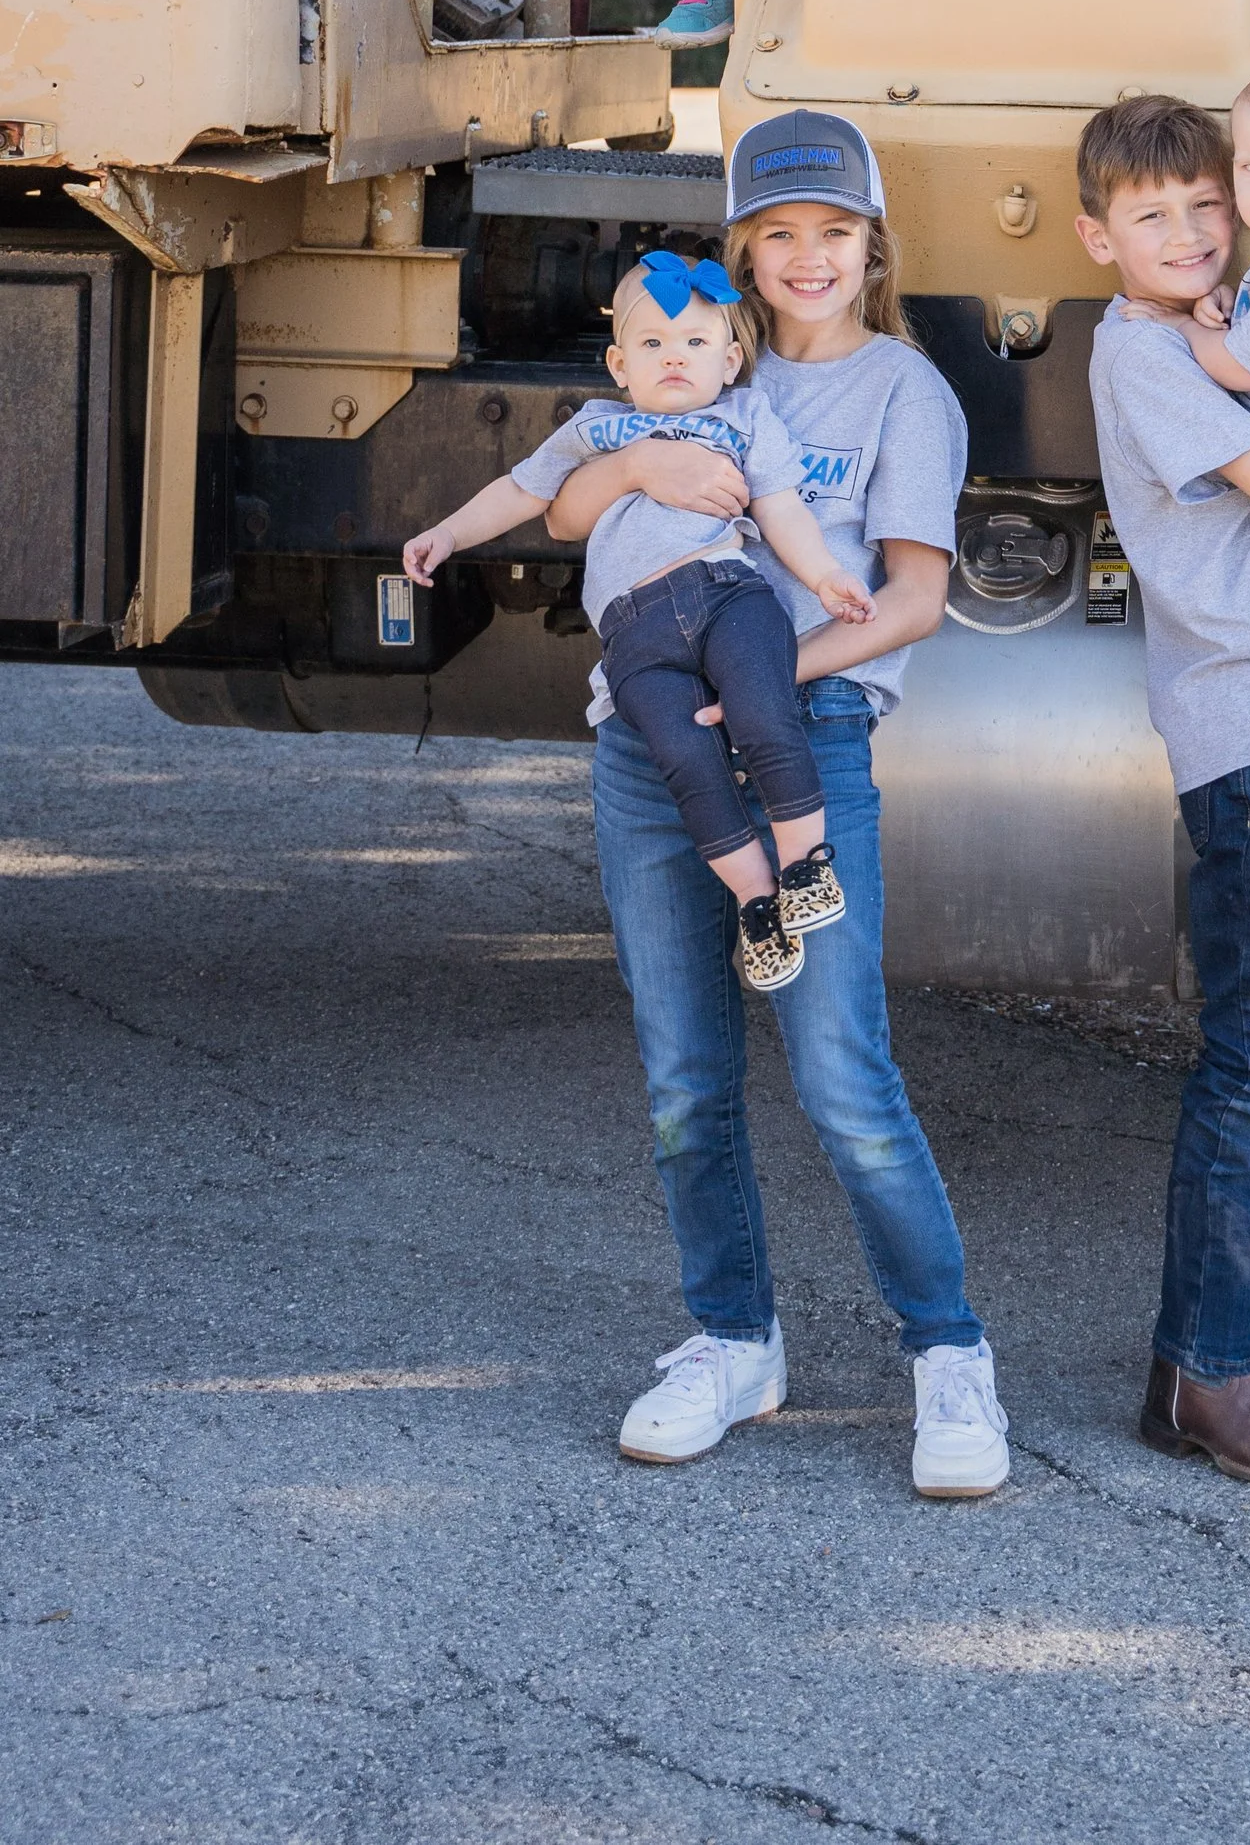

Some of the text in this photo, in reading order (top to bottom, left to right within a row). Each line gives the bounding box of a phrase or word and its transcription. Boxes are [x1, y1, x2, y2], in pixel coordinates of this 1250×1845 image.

[755, 147, 839, 173] BUSSELMAN
[766, 164, 828, 179] WATER WELLS
